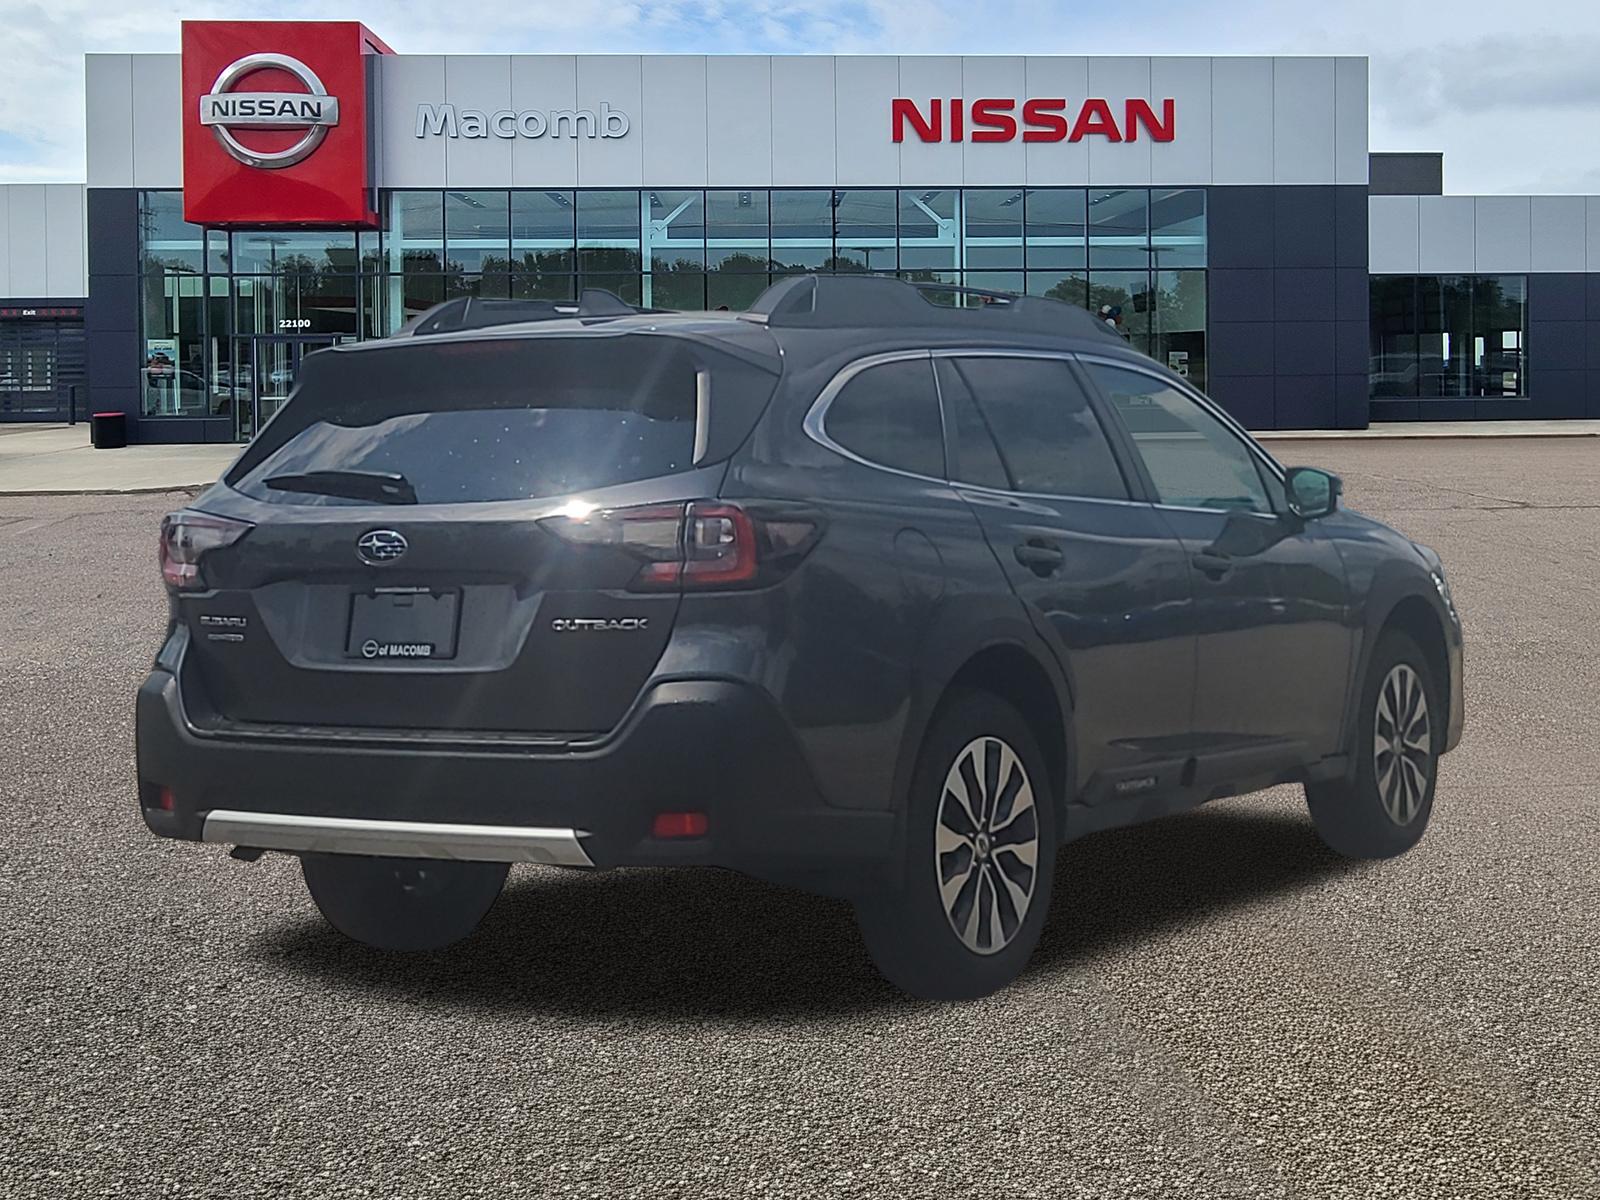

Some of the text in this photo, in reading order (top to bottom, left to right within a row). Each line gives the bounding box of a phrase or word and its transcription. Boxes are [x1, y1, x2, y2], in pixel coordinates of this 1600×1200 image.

[211, 100, 322, 118] NISSAN
[415, 101, 630, 139] Macomb
[892, 98, 1175, 143] NISSAN
[279, 319, 311, 328] 22100
[551, 618, 648, 630] OUTBACK
[389, 644, 431, 656] MACOMB
